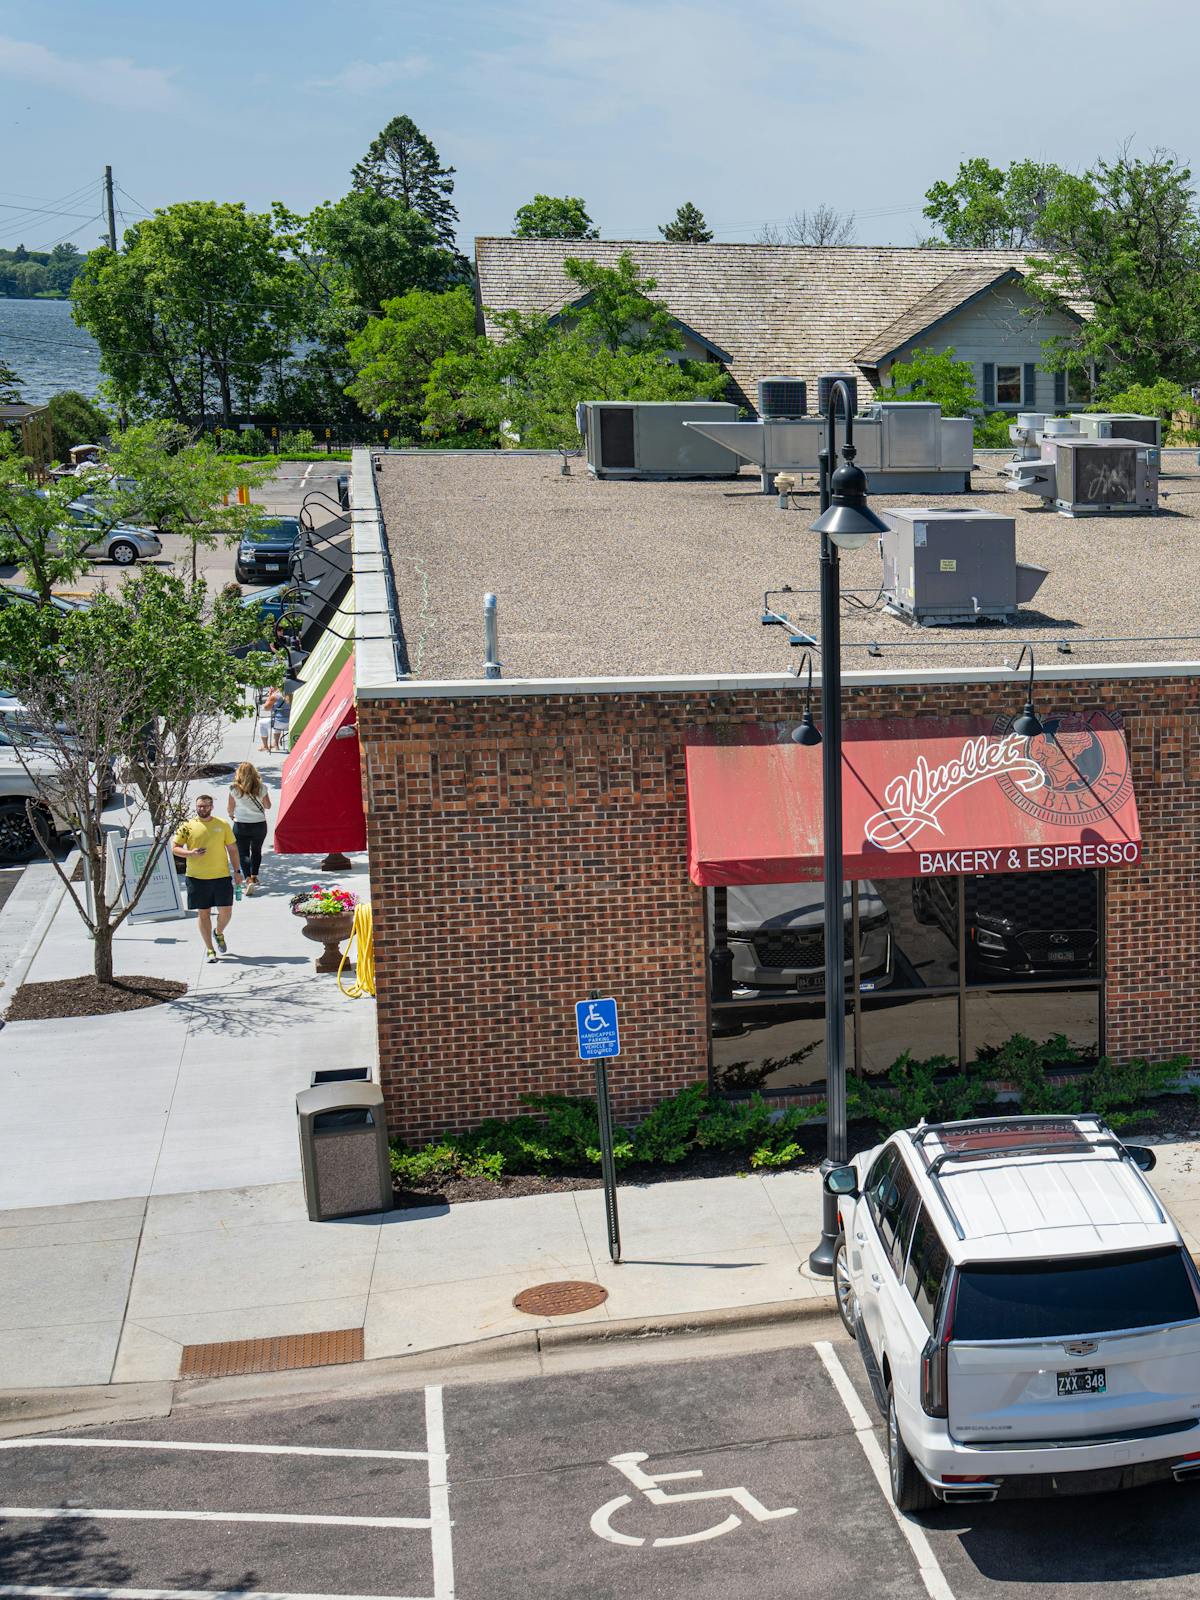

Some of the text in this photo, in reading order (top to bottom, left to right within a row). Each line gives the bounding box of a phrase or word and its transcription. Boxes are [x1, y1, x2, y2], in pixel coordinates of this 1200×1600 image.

[884, 732, 1029, 817] Wuollet
[1042, 765, 1122, 812] BAKRY
[919, 843, 1138, 873] BAKERY & ESPRESSO
[1058, 1373, 1105, 1391] ZXX 348
